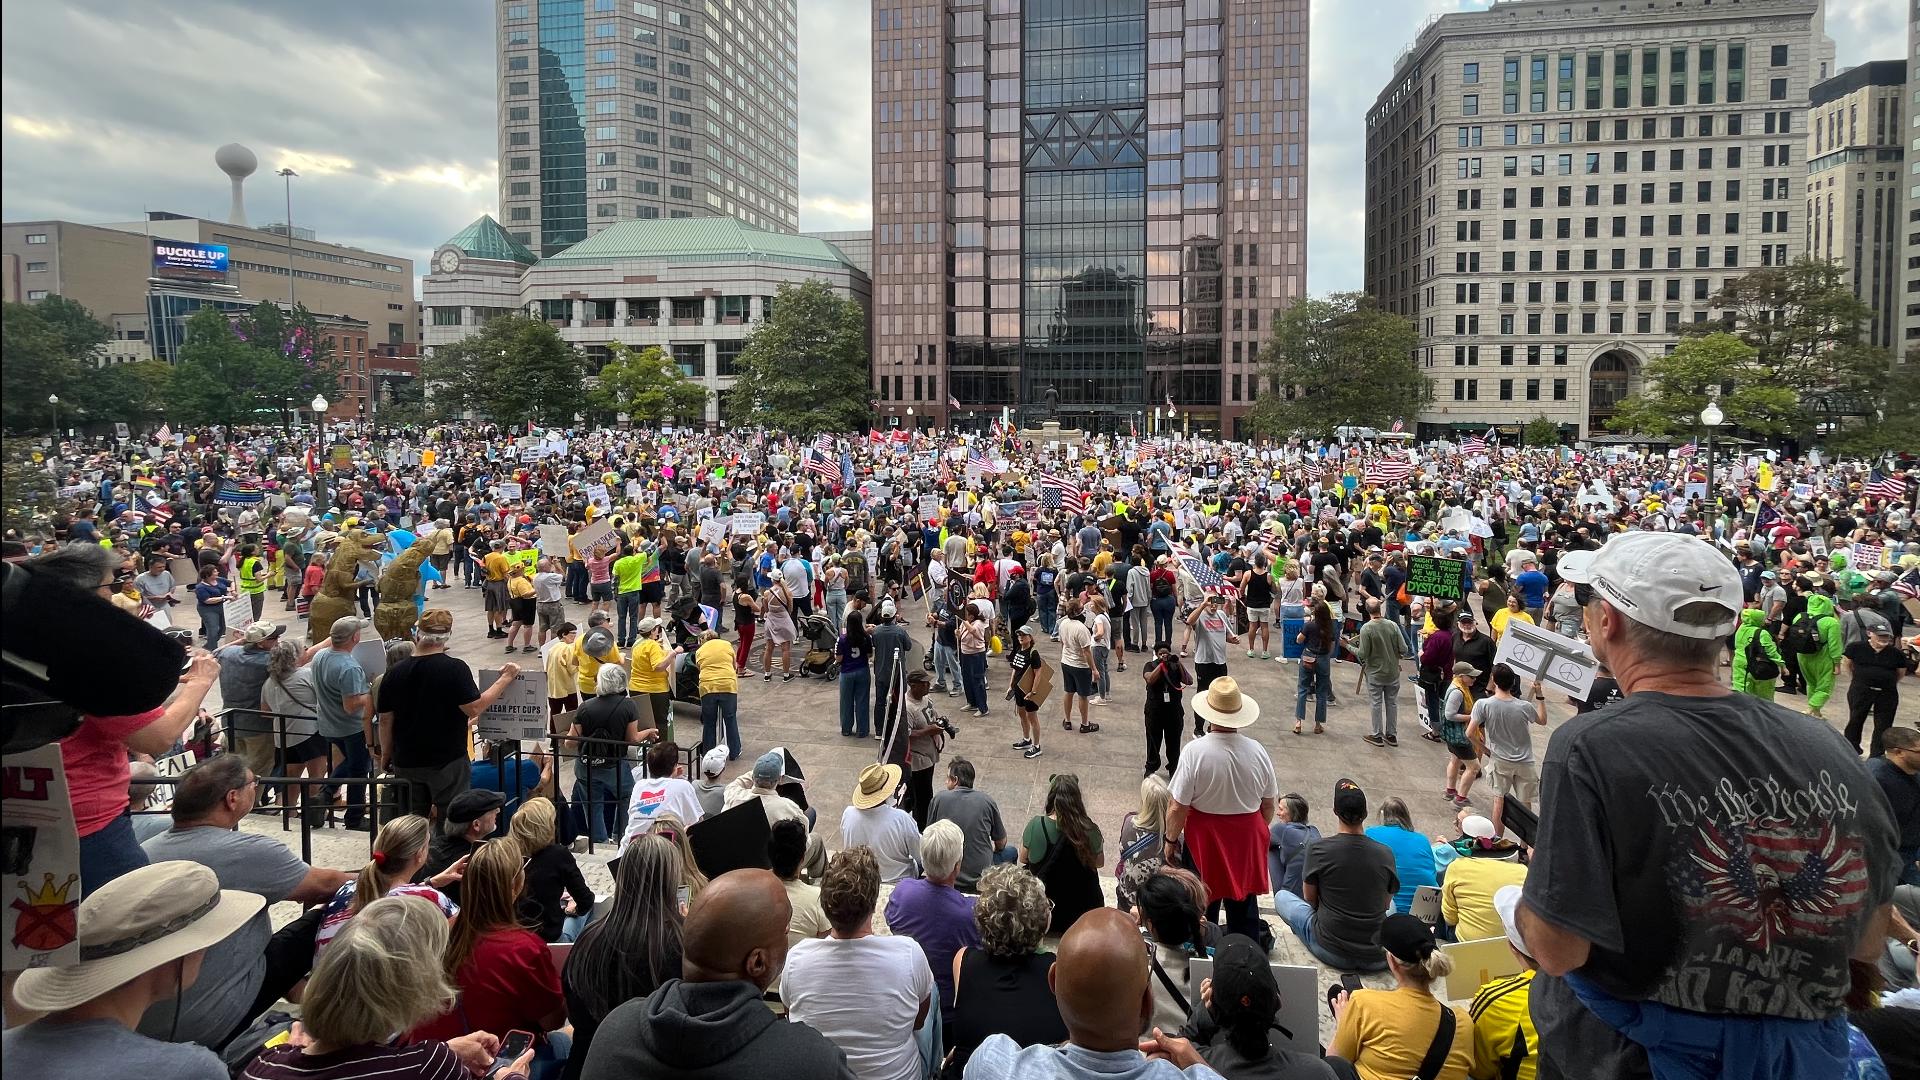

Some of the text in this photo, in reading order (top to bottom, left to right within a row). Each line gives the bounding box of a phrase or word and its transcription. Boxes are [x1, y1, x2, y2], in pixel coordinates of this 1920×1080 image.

[156, 246, 225, 260] BUCKLE UP
[1438, 559, 1462, 568] YARVIN
[1439, 565, 1462, 573] TRUMP
[1411, 574, 1459, 586] ACCEPT YOUR
[1425, 570, 1442, 578] WILL
[1444, 572, 1461, 580] NOT
[1407, 580, 1461, 599] DYSTOPIA
[508, 705, 520, 714] PET
[522, 705, 541, 714] CUPS
[158, 754, 197, 778] EAL
[1646, 770, 1859, 834] We the People
